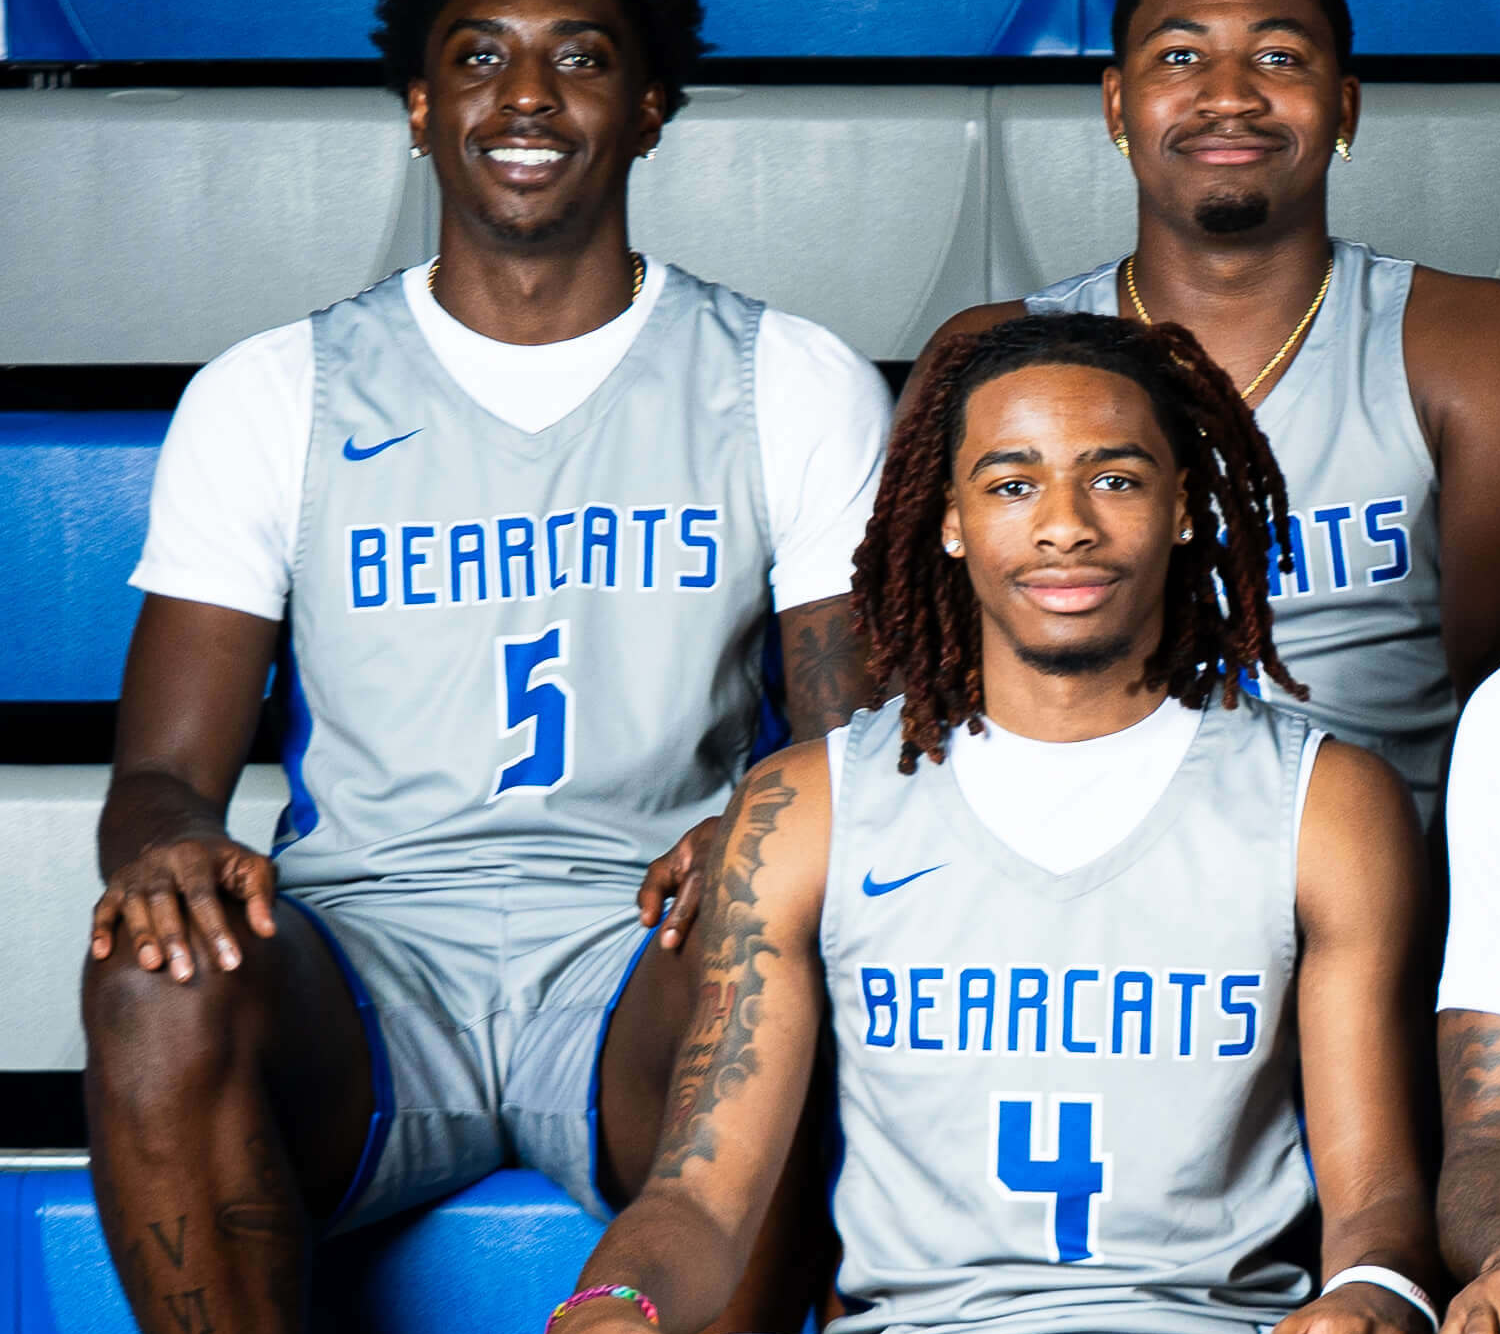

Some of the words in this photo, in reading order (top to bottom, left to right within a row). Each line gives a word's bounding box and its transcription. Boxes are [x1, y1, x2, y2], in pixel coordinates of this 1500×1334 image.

[344, 503, 724, 613] BEARCATS
[486, 619, 574, 805] 5
[855, 962, 1268, 1061] BEARCATS
[988, 1092, 1114, 1264] 4
